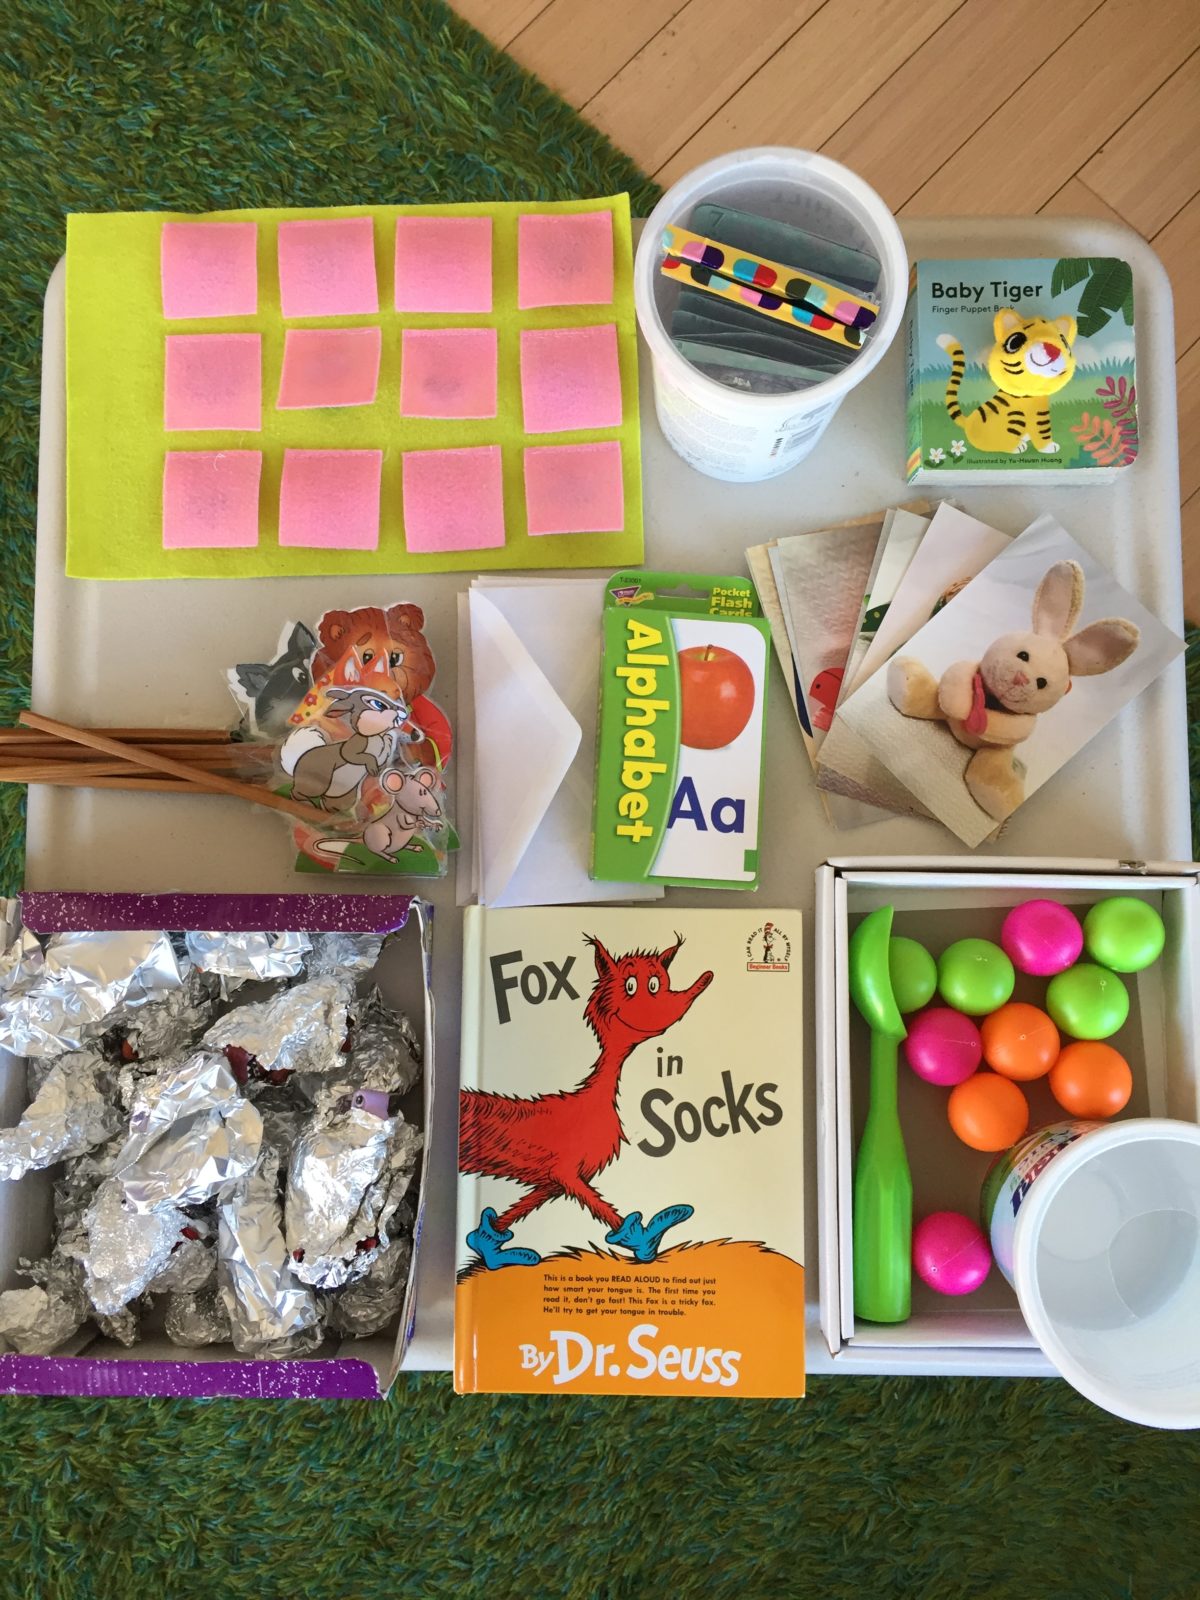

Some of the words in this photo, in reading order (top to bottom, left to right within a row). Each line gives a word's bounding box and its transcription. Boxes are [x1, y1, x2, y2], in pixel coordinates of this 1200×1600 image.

[931, 281, 984, 303] Baby
[990, 280, 1043, 302] Tiger
[932, 305, 959, 315] Finger
[961, 305, 991, 314] Puppet
[993, 304, 1014, 312] Bk
[712, 587, 751, 597] Pocket
[711, 596, 752, 608] Flash
[616, 619, 670, 842] Alphabet
[667, 776, 745, 833] Aa
[490, 950, 580, 1024] Fox
[656, 1046, 683, 1077] in
[637, 1070, 784, 1158] Socks
[544, 1274, 558, 1282] This
[595, 1276, 609, 1284] you
[633, 1275, 660, 1283] ALOUD
[672, 1276, 687, 1284] find
[703, 1277, 716, 1285] just
[607, 1286, 633, 1294] tongue
[648, 1286, 661, 1294] The
[608, 1296, 626, 1304] fast!
[679, 1298, 699, 1307] tricky
[701, 1298, 716, 1306] fox.
[563, 1307, 573, 1315] try
[620, 1308, 645, 1316] tongue
[658, 1308, 686, 1316] trouble.
[519, 1344, 555, 1377] By
[550, 1330, 621, 1385] Dr.
[626, 1323, 742, 1387] Seuss
